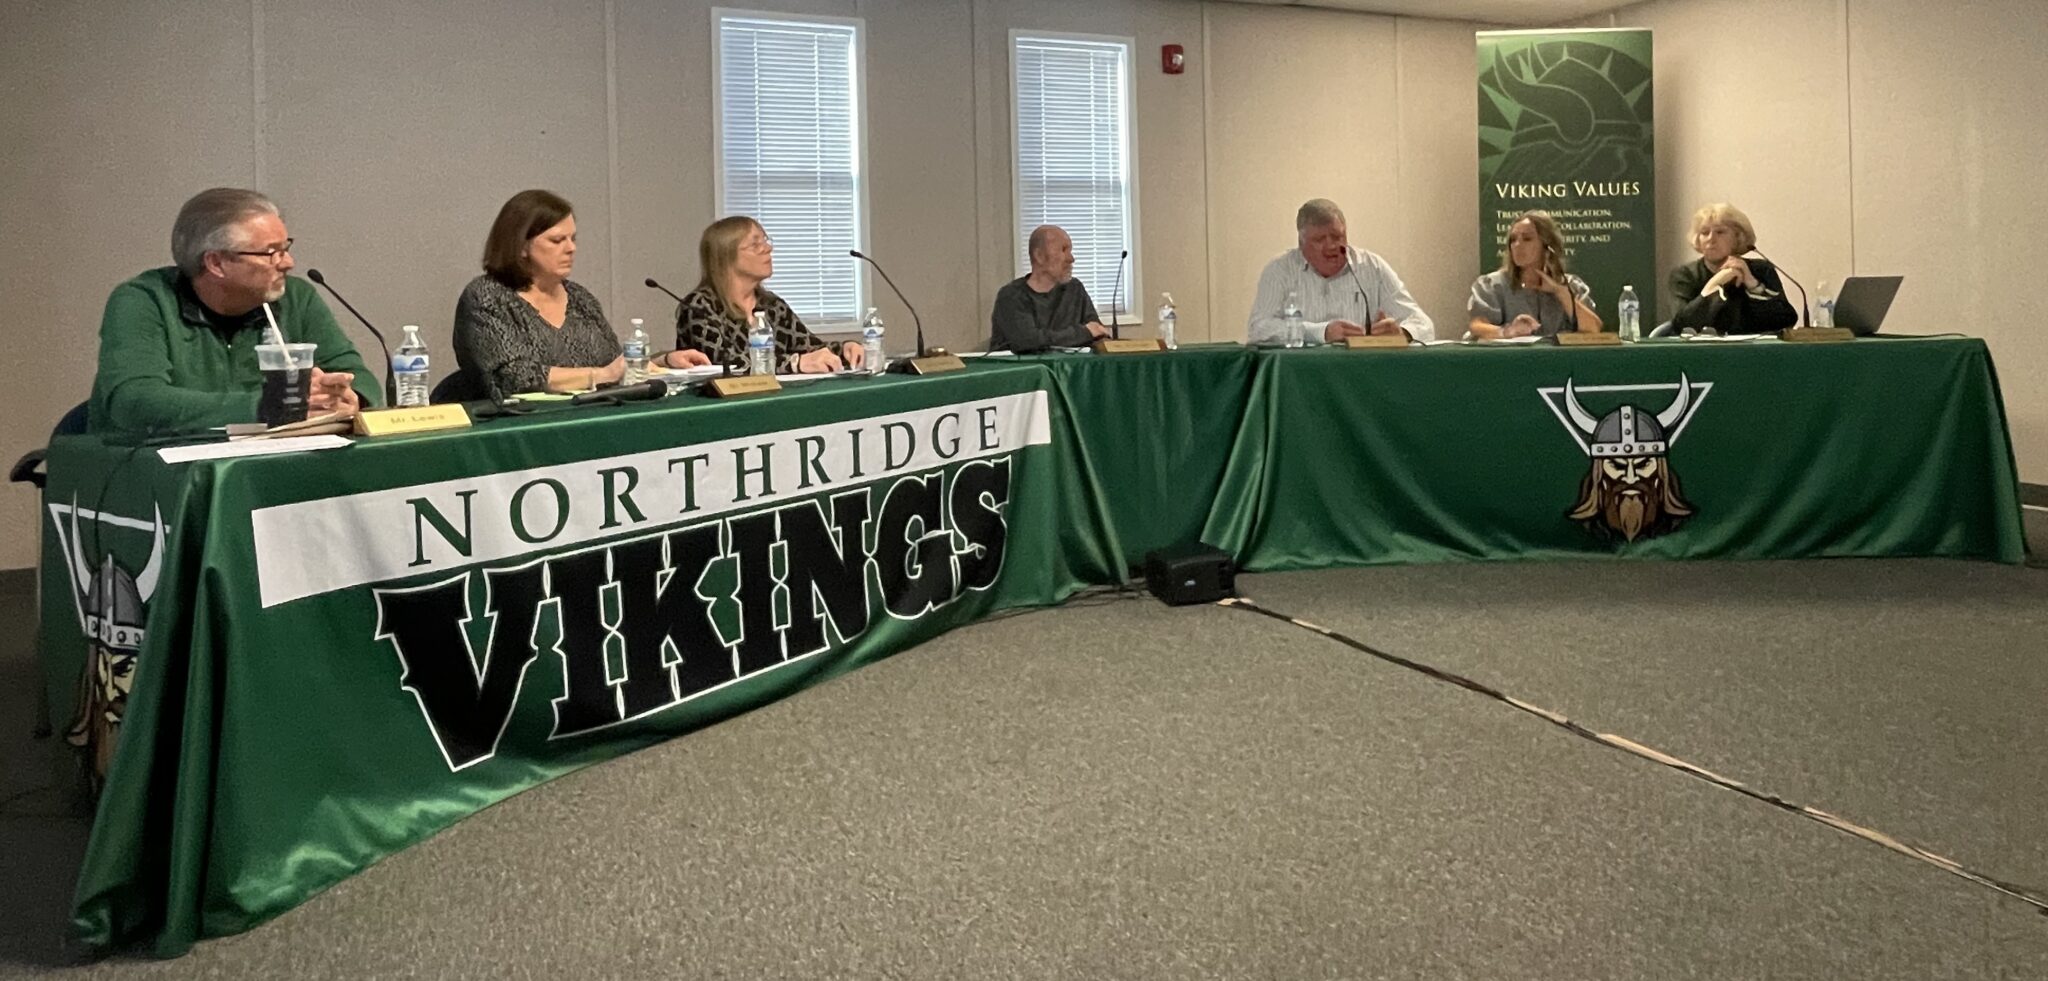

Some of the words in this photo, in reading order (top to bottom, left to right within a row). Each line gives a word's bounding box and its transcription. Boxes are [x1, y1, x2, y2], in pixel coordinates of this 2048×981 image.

[1496, 183, 1566, 199] VIKING
[1574, 181, 1640, 197] VALUES
[1589, 234, 1612, 243] AND
[406, 406, 1001, 568] NORTHRIDGE
[373, 455, 1012, 772] VIKINGS
